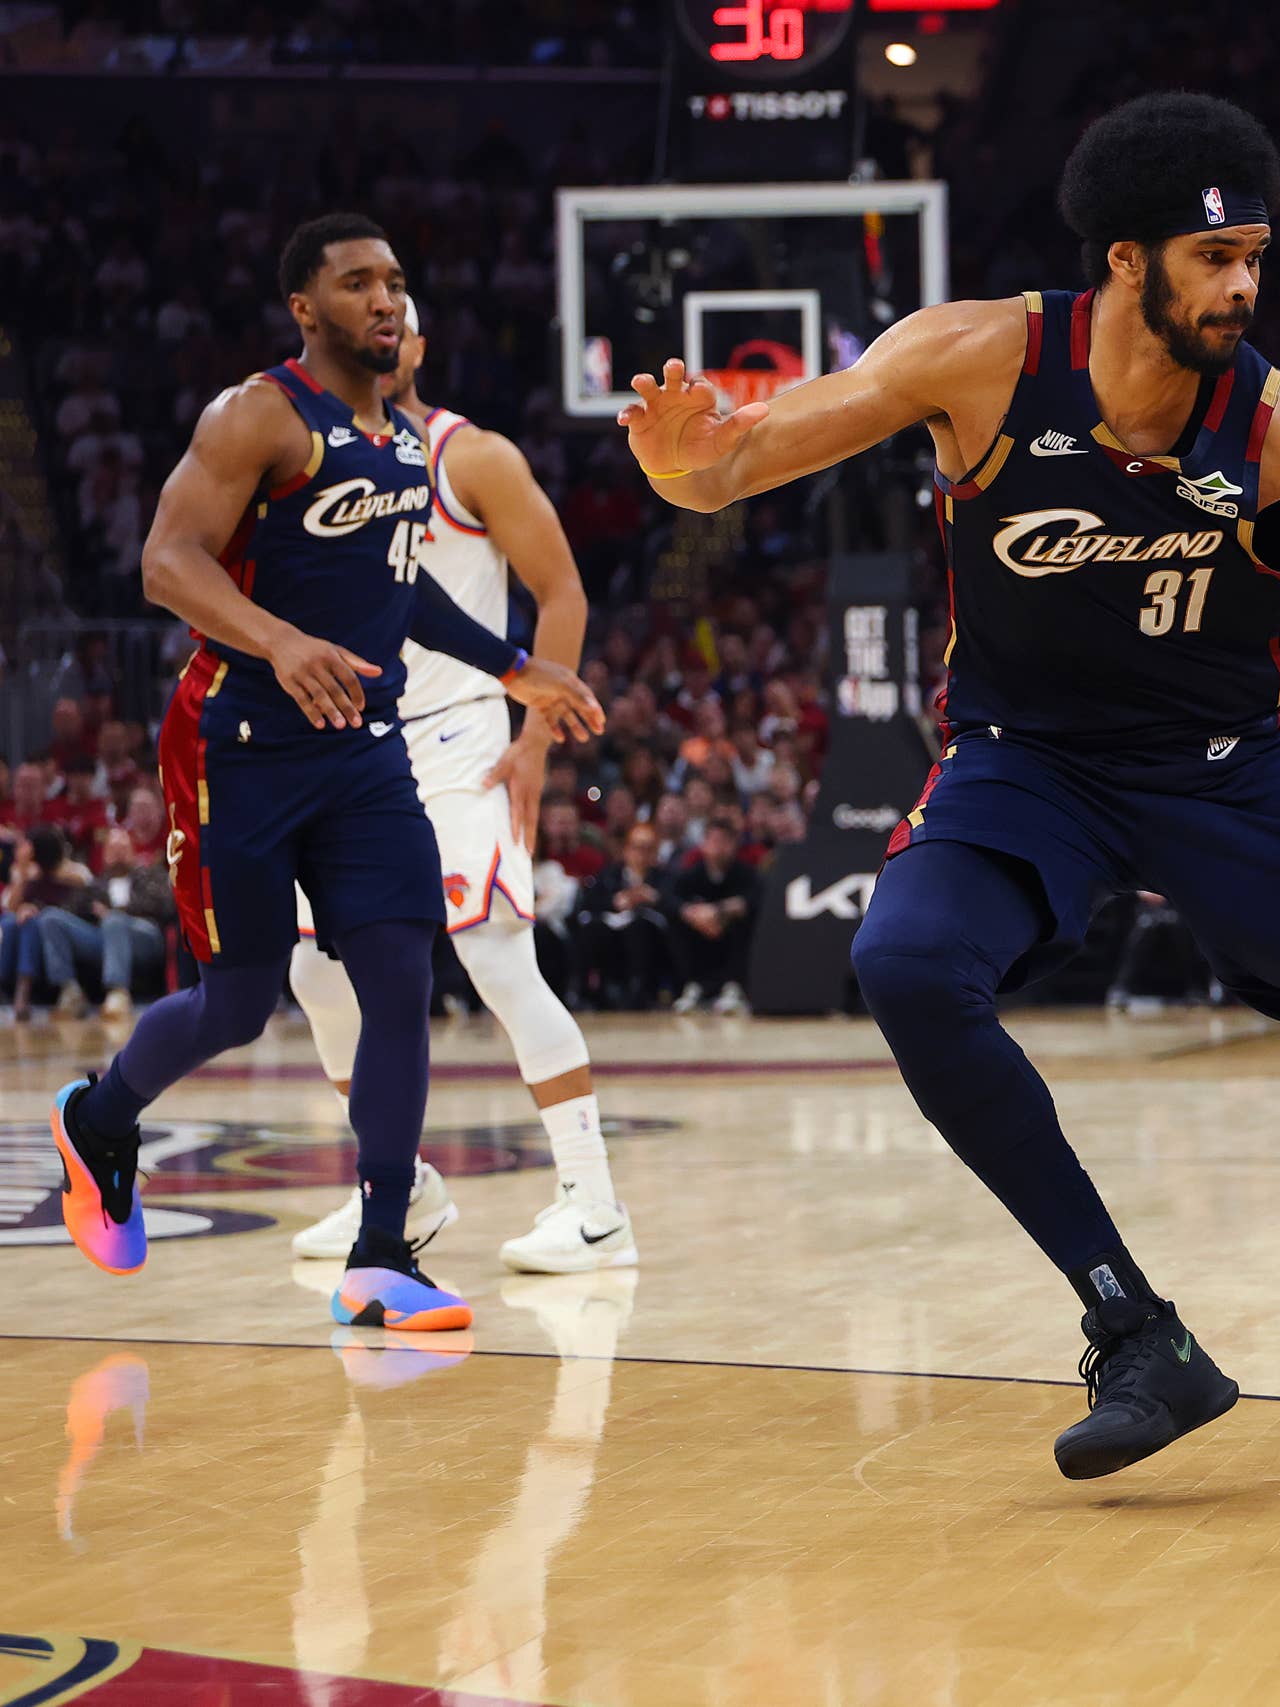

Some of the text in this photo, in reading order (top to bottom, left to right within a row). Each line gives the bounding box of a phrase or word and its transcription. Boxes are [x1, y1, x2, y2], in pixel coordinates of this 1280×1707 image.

[1039, 429, 1078, 450] NIKE
[302, 477, 430, 538] CLEVELAND
[1177, 486, 1237, 516] CLIFFS
[387, 519, 427, 586] 45
[993, 507, 1225, 579] CLEVELAND
[1138, 566, 1216, 638] 31
